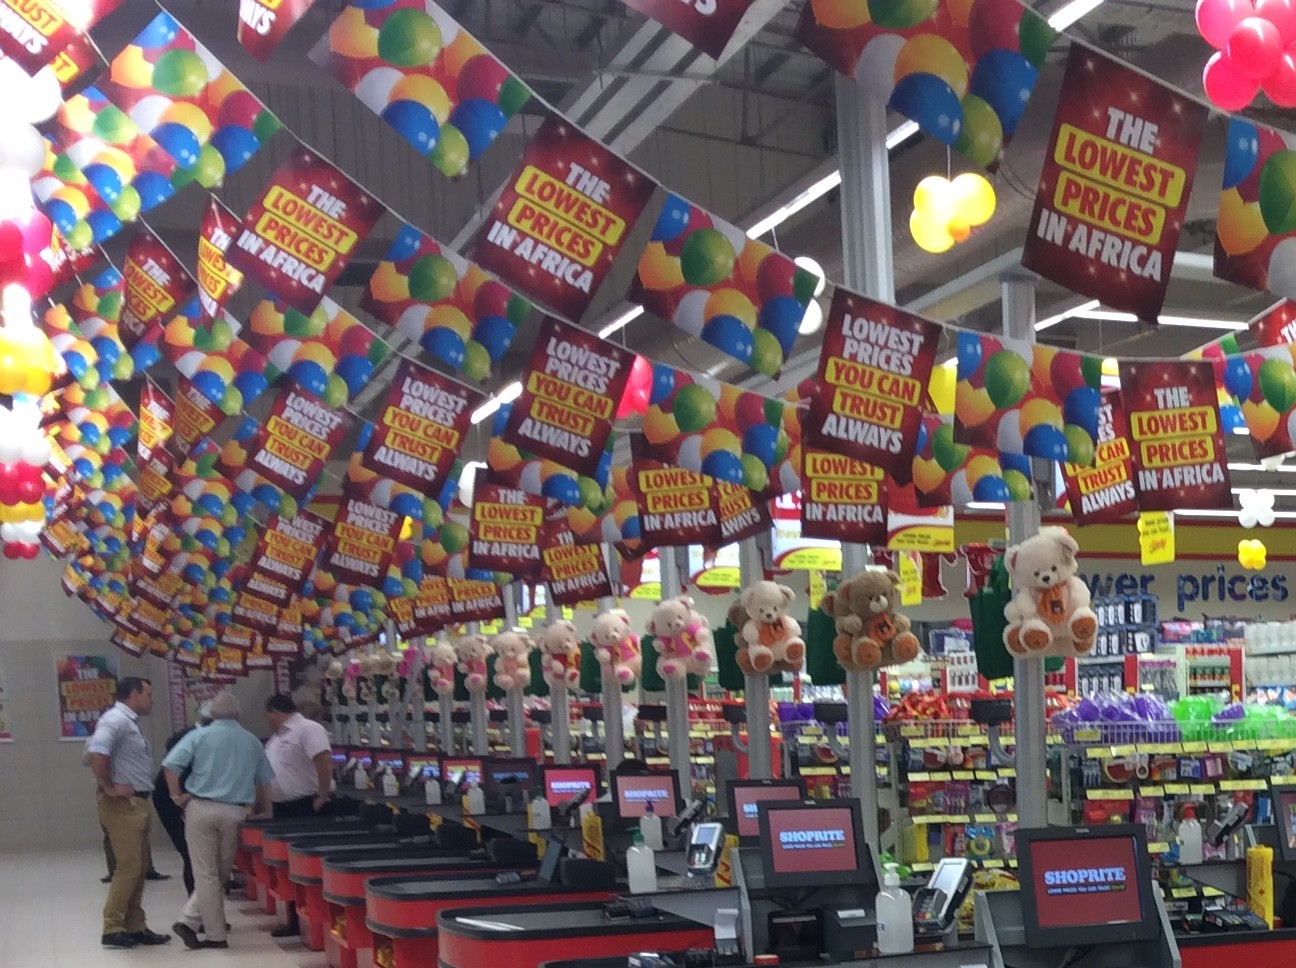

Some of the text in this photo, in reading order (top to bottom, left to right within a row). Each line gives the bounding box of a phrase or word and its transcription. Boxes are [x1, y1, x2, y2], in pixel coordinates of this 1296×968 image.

[15, 0, 57, 29] RUST
[1106, 107, 1158, 154] THE
[1064, 132, 1175, 199] LOWEST
[565, 162, 610, 204] THE
[306, 184, 347, 218] THE
[525, 174, 616, 235] LOWEST
[1061, 178, 1156, 236] PRICES
[272, 191, 349, 247] LOWEST
[515, 204, 595, 259] PRICES
[262, 220, 327, 265] PRICES
[487, 221, 594, 294] IN AFRICA
[1037, 208, 1163, 282] IN AFRICA
[142, 258, 171, 285] THE
[236, 229, 327, 294] IN AFRICA
[842, 313, 924, 354] LOWEST
[546, 336, 621, 379] LOWEST
[843, 337, 913, 376] PRICES
[545, 359, 610, 393] PRICES
[834, 361, 916, 401] YOU CAN
[402, 377, 468, 414] LOWEST
[534, 376, 610, 413] YOU CAN
[840, 391, 899, 423] TRUST
[1154, 386, 1190, 409] THE
[281, 407, 330, 440] PRICES
[286, 392, 342, 430] LOWEST
[399, 396, 457, 427] PRICES
[534, 401, 592, 432] TRUST
[1138, 411, 1208, 436] LOWEST
[273, 421, 326, 454] YOU CAN
[390, 411, 455, 445] YOU CAN
[518, 417, 592, 458] ALWAYS
[822, 413, 903, 454] ALWAYS
[273, 440, 308, 464] TRUST
[390, 430, 438, 458] TRUST
[1098, 442, 1126, 461] CAN
[1147, 440, 1208, 464] PRICES
[254, 449, 308, 485] ALWAYS
[373, 446, 438, 482] ALWAYS
[1081, 465, 1123, 490] TRUST
[1138, 463, 1225, 491] IN AFRICA
[498, 489, 526, 505] THE
[652, 493, 704, 510] PRICES
[816, 483, 873, 500] PRICES
[1082, 480, 1135, 515] ALWAYS
[346, 513, 391, 535] PRICES
[347, 499, 398, 524] LOWEST
[481, 505, 537, 521] LOWEST
[644, 510, 717, 531] IN AFRICA
[806, 503, 883, 523] IN AFRICA
[341, 525, 363, 540] YOU
[483, 524, 531, 541] PRICES
[330, 552, 380, 578] ALWAYS
[473, 540, 540, 560] IN AFRICA
[556, 558, 594, 576] PRICES
[457, 585, 492, 598] PRICES
[551, 572, 607, 595] IN AFRICA
[1079, 564, 1289, 611] wer prices
[452, 596, 502, 613] IN AFRICA
[780, 830, 845, 842] SHOPRITE
[1044, 867, 1126, 885] SHOPRITE
